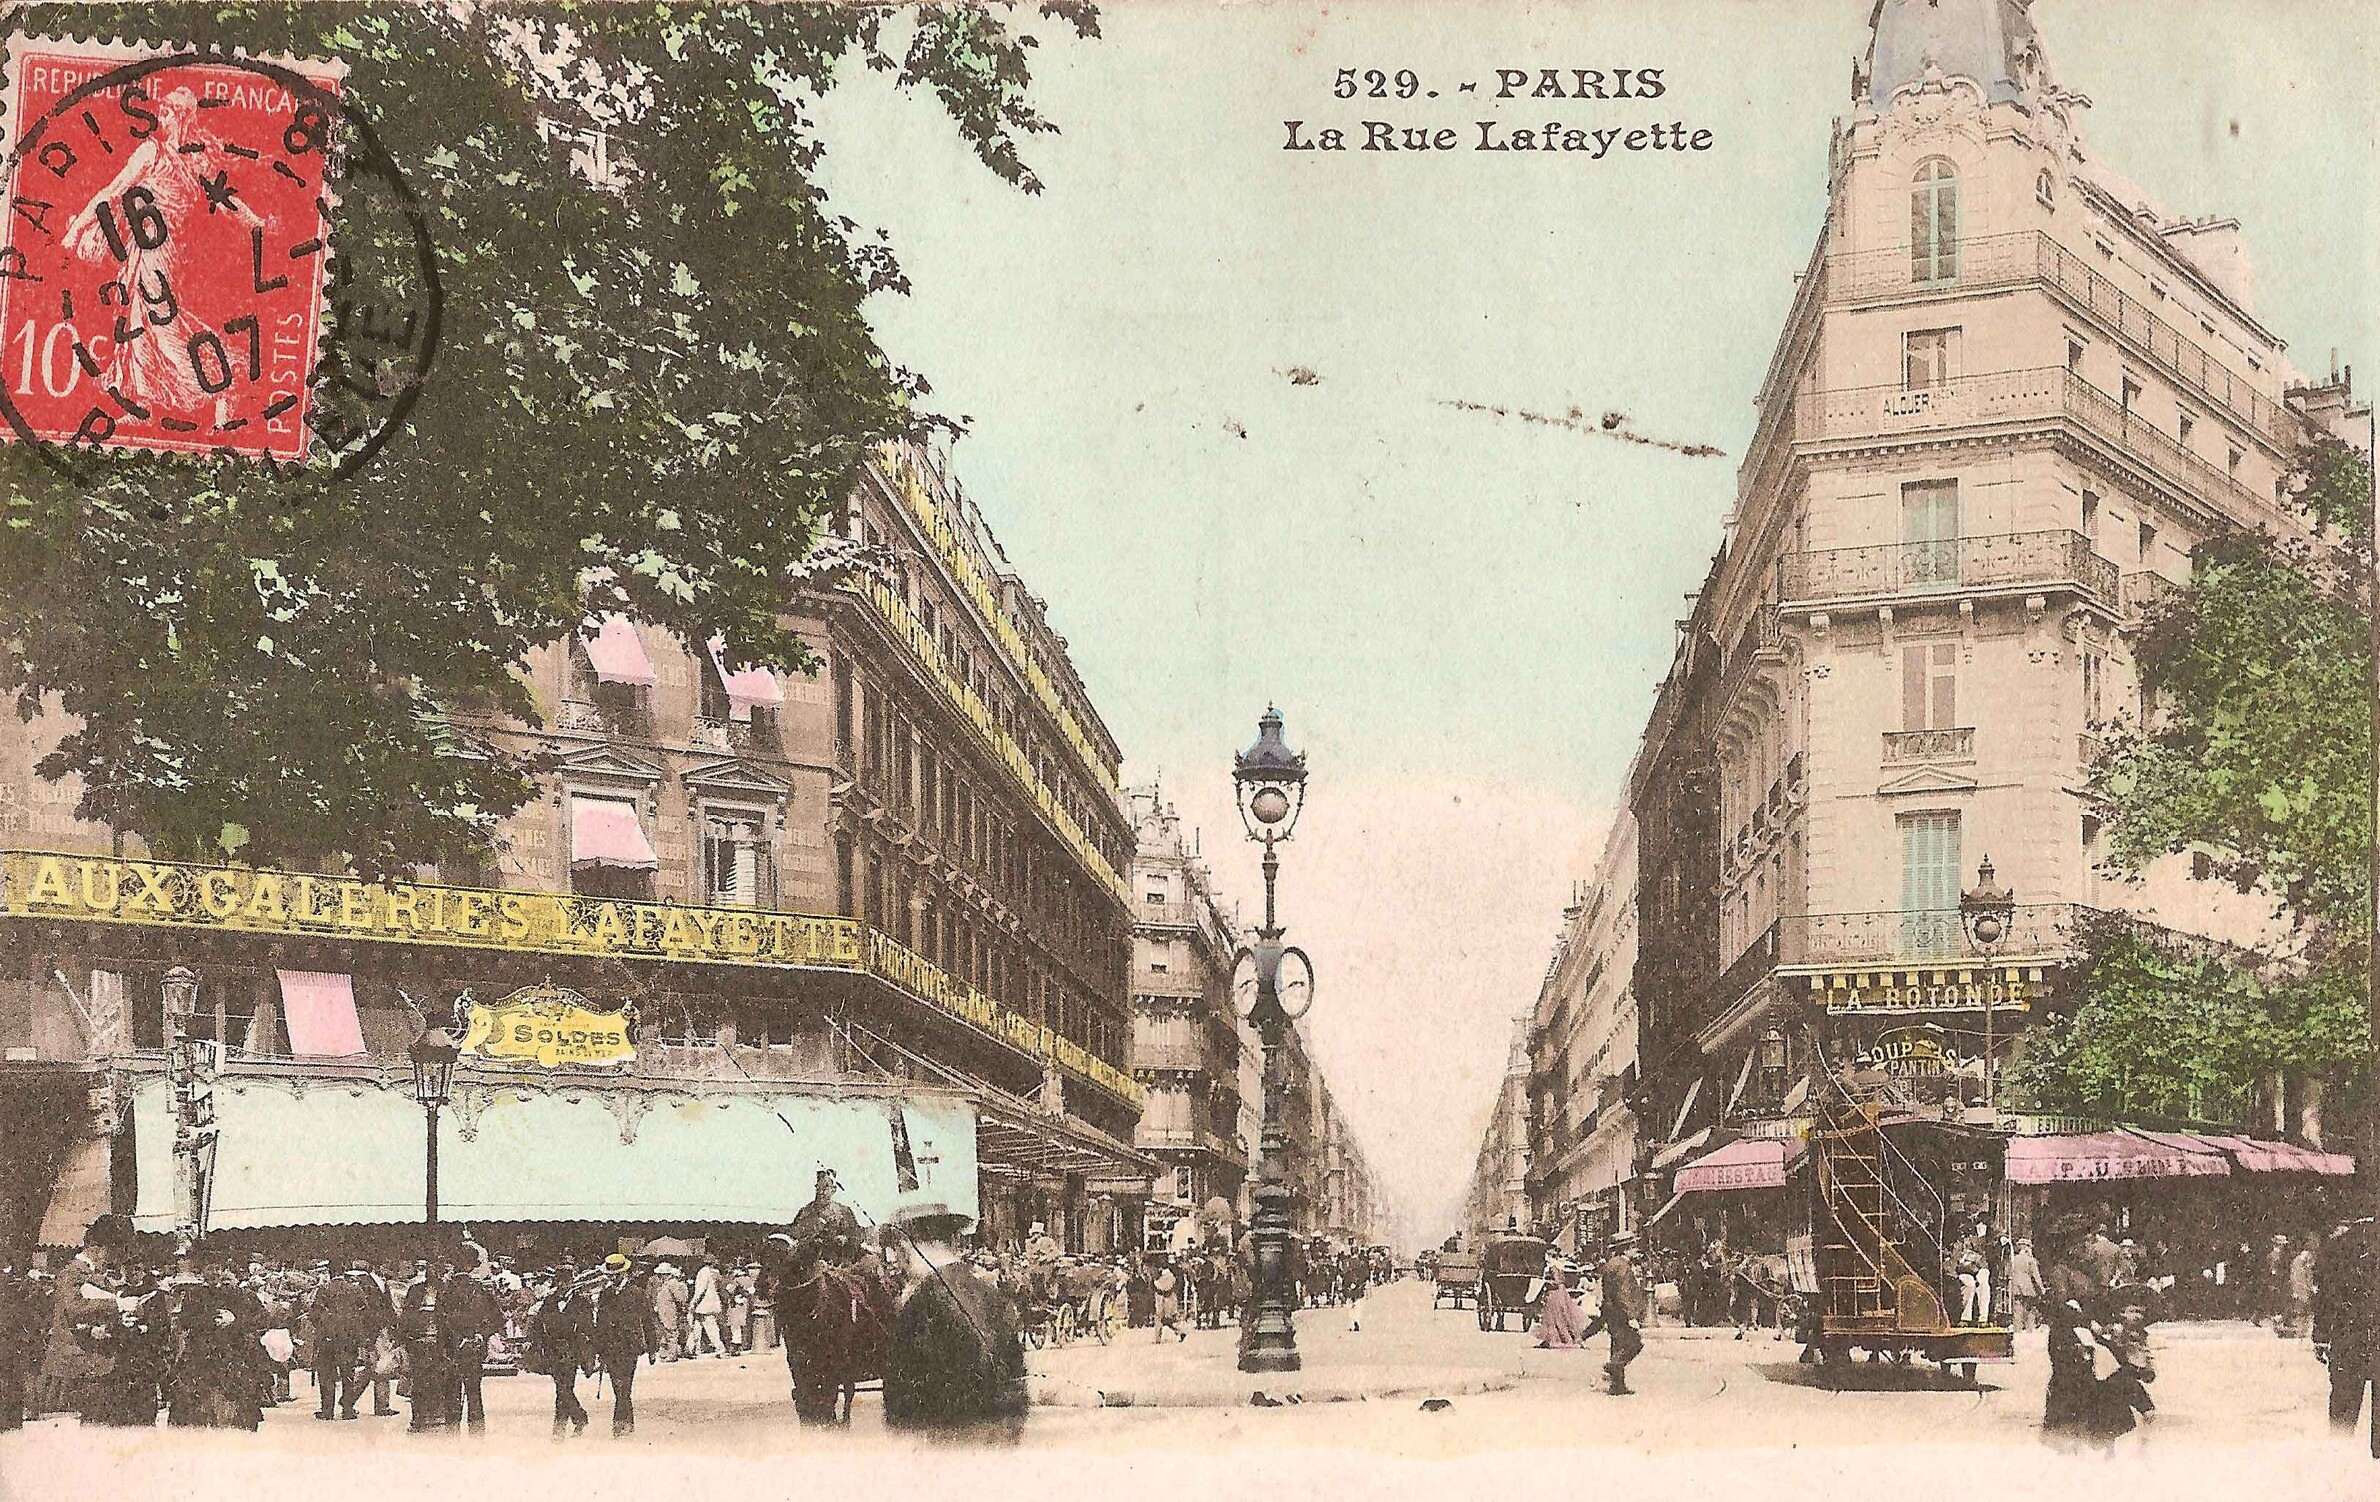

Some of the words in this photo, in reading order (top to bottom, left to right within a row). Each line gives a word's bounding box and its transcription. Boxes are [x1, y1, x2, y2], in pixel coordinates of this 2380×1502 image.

[27, 857, 175, 912] AUX
[200, 868, 531, 941] GALERIES
[556, 899, 860, 961] LAFAYETTE
[1827, 988, 1862, 1013] LA
[1886, 982, 2025, 1009] ROTONDE
[515, 1024, 620, 1046] SOLDES
